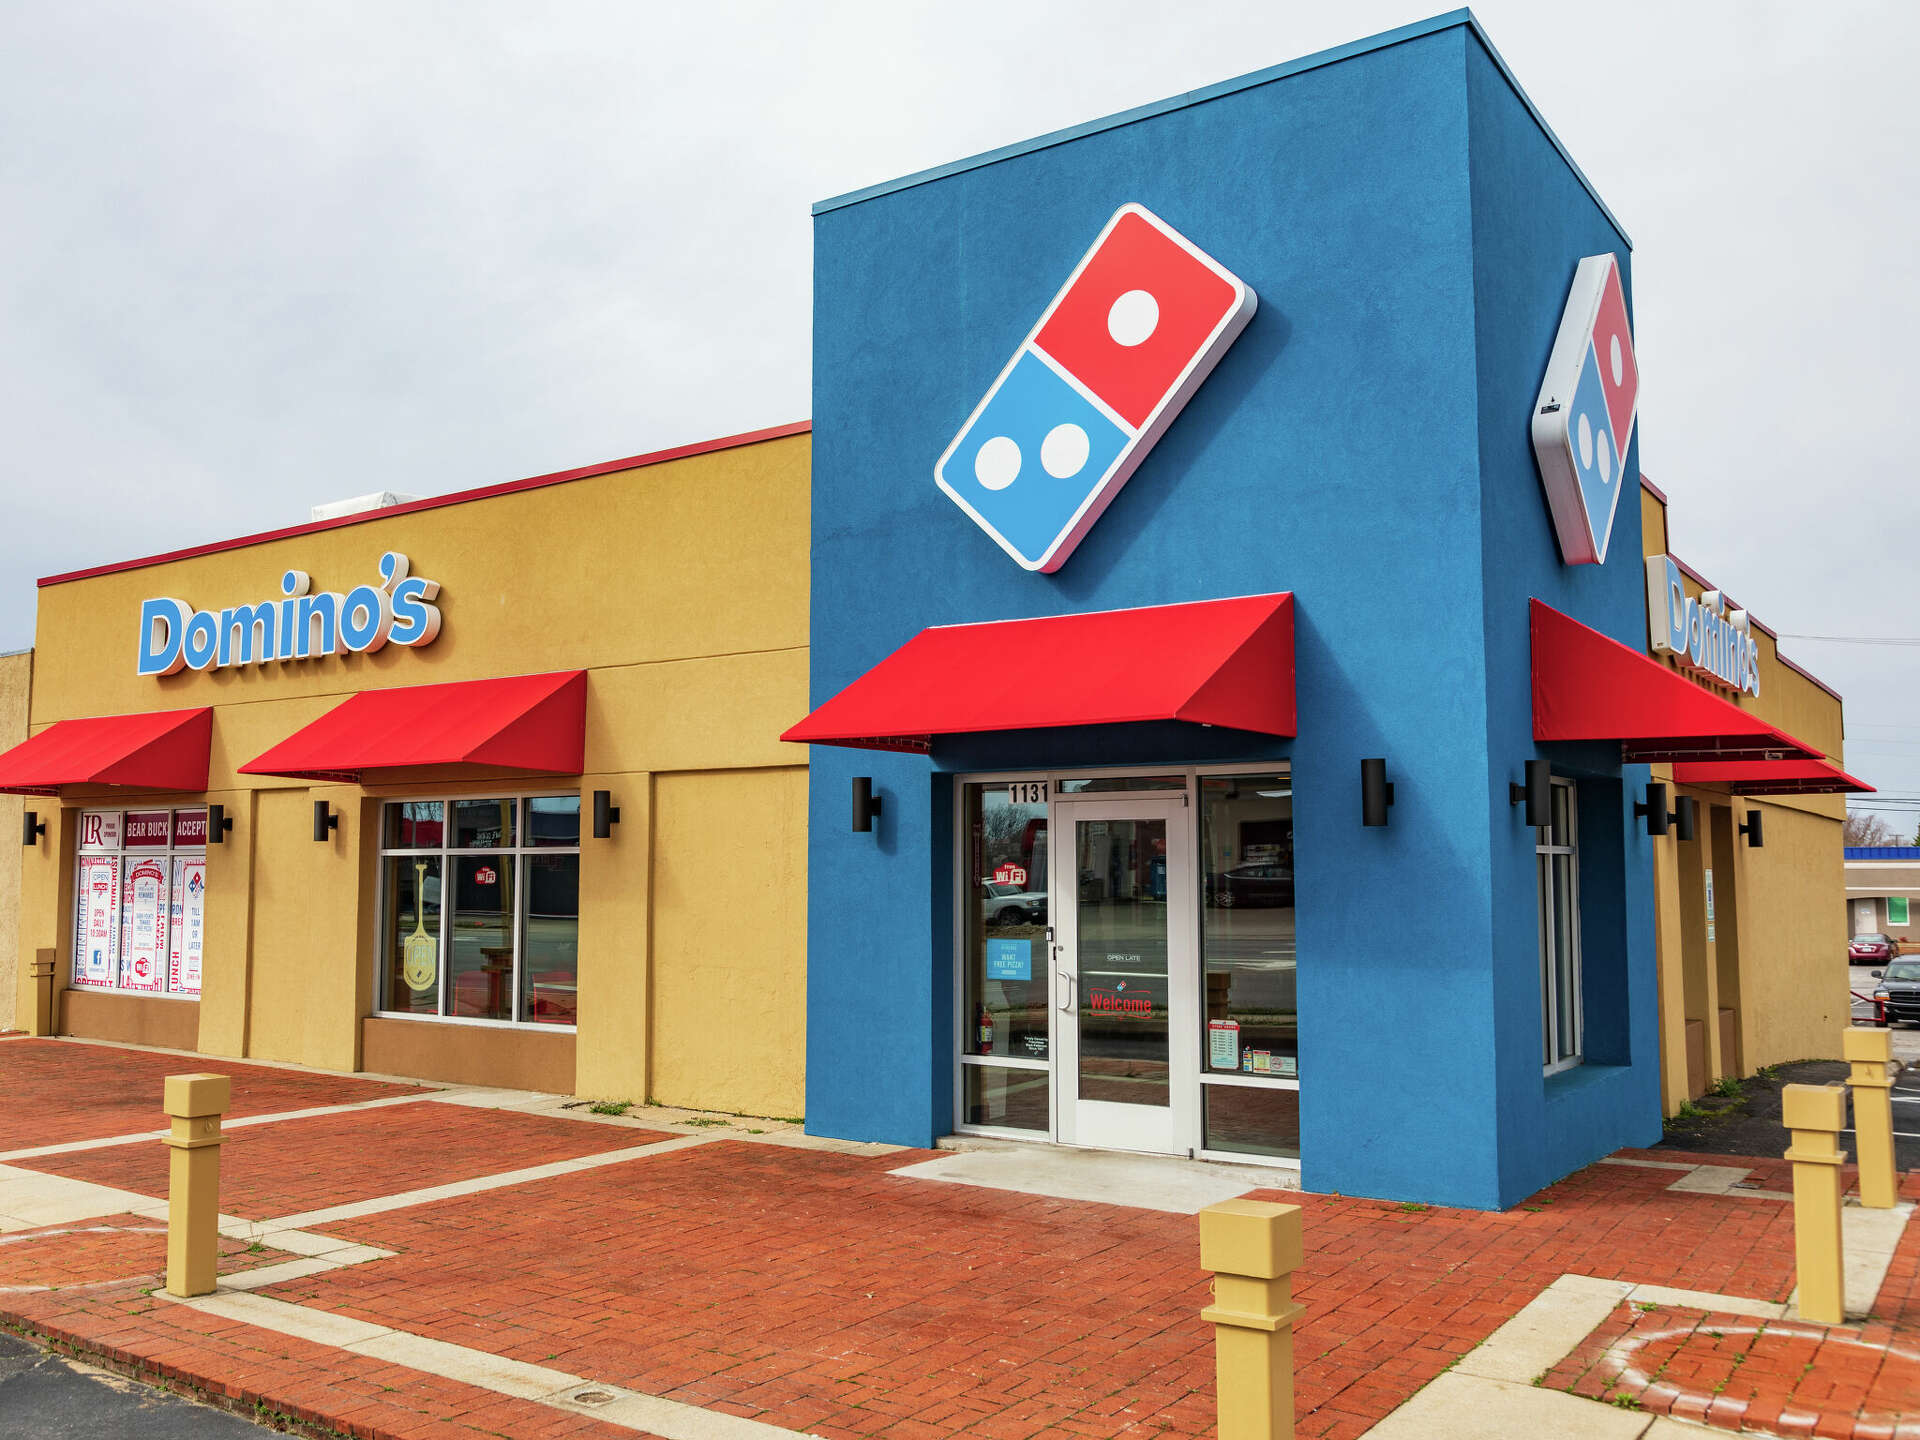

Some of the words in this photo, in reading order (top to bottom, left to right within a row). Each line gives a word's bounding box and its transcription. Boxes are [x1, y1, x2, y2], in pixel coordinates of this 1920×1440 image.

[137, 551, 438, 676] Domino's
[1660, 555, 1760, 698] Domino's
[1010, 783, 1048, 803] 1131
[127, 822, 146, 837] BEAR
[147, 821, 168, 837] BUCK
[176, 820, 207, 836] ACCEPT
[1106, 953, 1125, 961] OPEN
[171, 951, 180, 992] LUNCH
[1089, 991, 1152, 1014] Welcome
